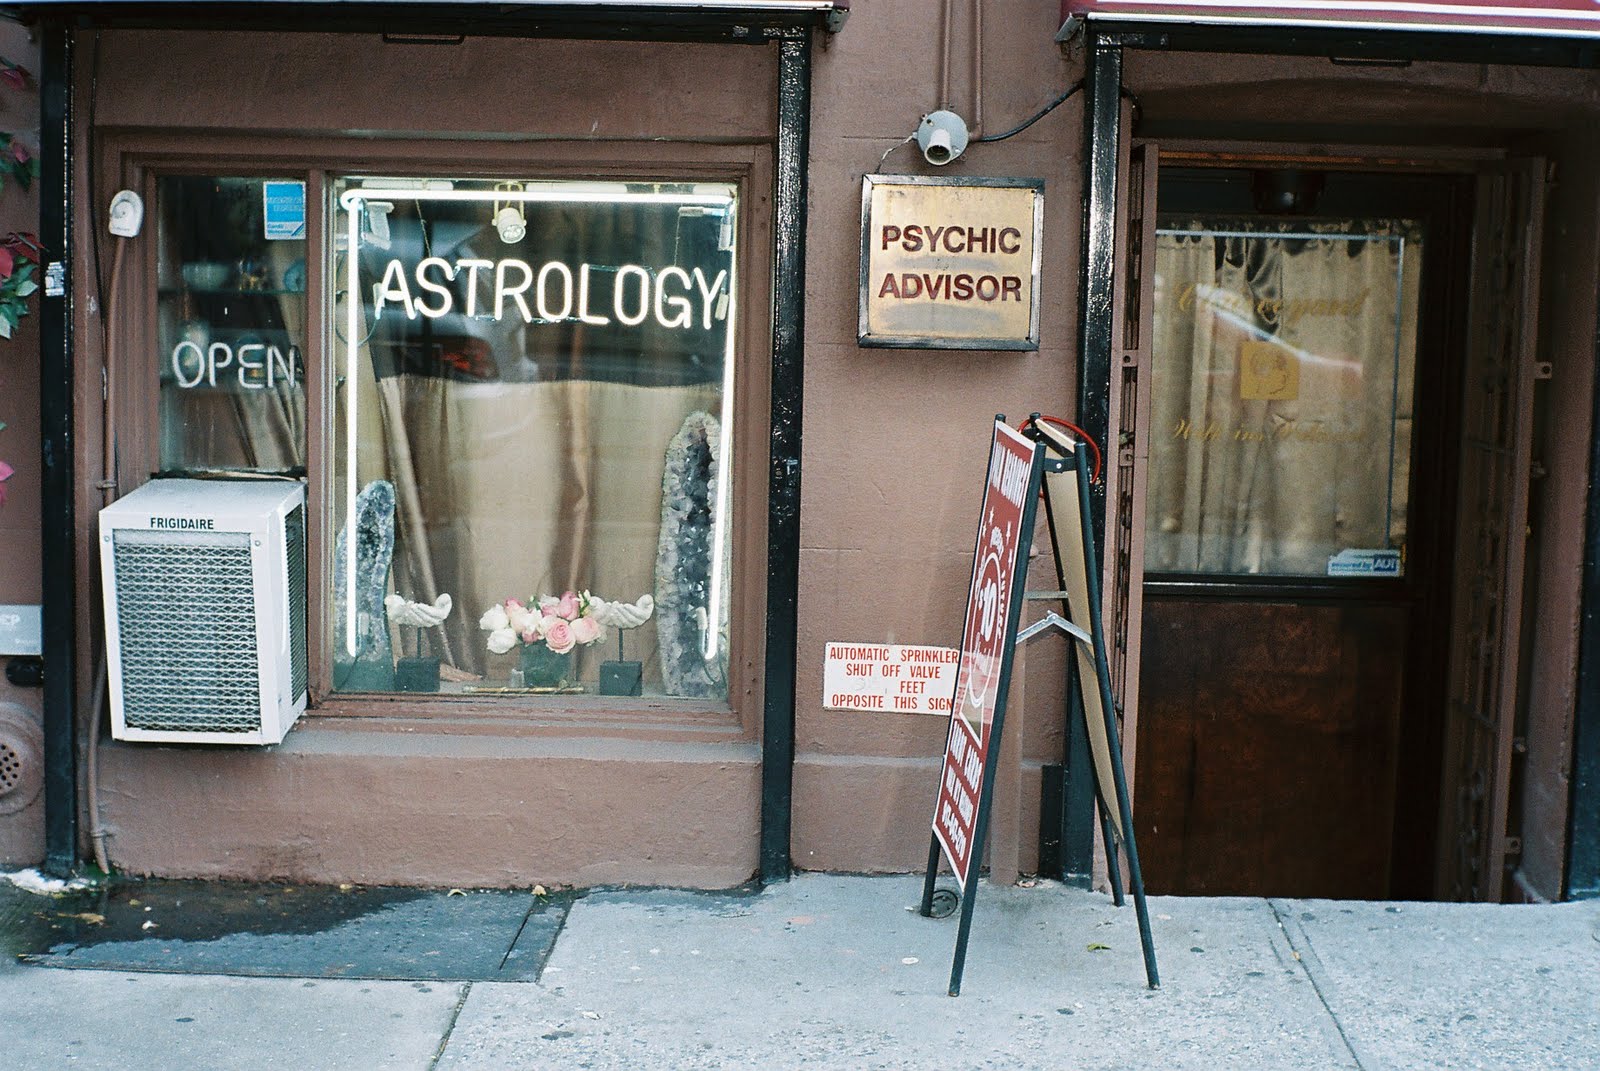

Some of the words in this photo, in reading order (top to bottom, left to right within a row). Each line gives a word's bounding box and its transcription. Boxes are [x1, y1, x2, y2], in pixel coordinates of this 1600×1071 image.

[881, 225, 1022, 255] PSYCHIC
[375, 258, 727, 330] ASTROLOGY
[878, 273, 1023, 302] ADVISOR
[172, 341, 297, 389] OPEN
[150, 517, 214, 529] FRIGIDAIRE
[829, 647, 890, 661] AUTOMATIC
[900, 649, 959, 664] SPRINKLER
[846, 663, 874, 676] SHUT
[882, 664, 901, 677] OFF
[910, 666, 940, 678] VALVE
[900, 681, 925, 693] FEET
[832, 694, 884, 708] OPPOSITE
[894, 696, 918, 709] THIS
[928, 698, 953, 710] SIGN
